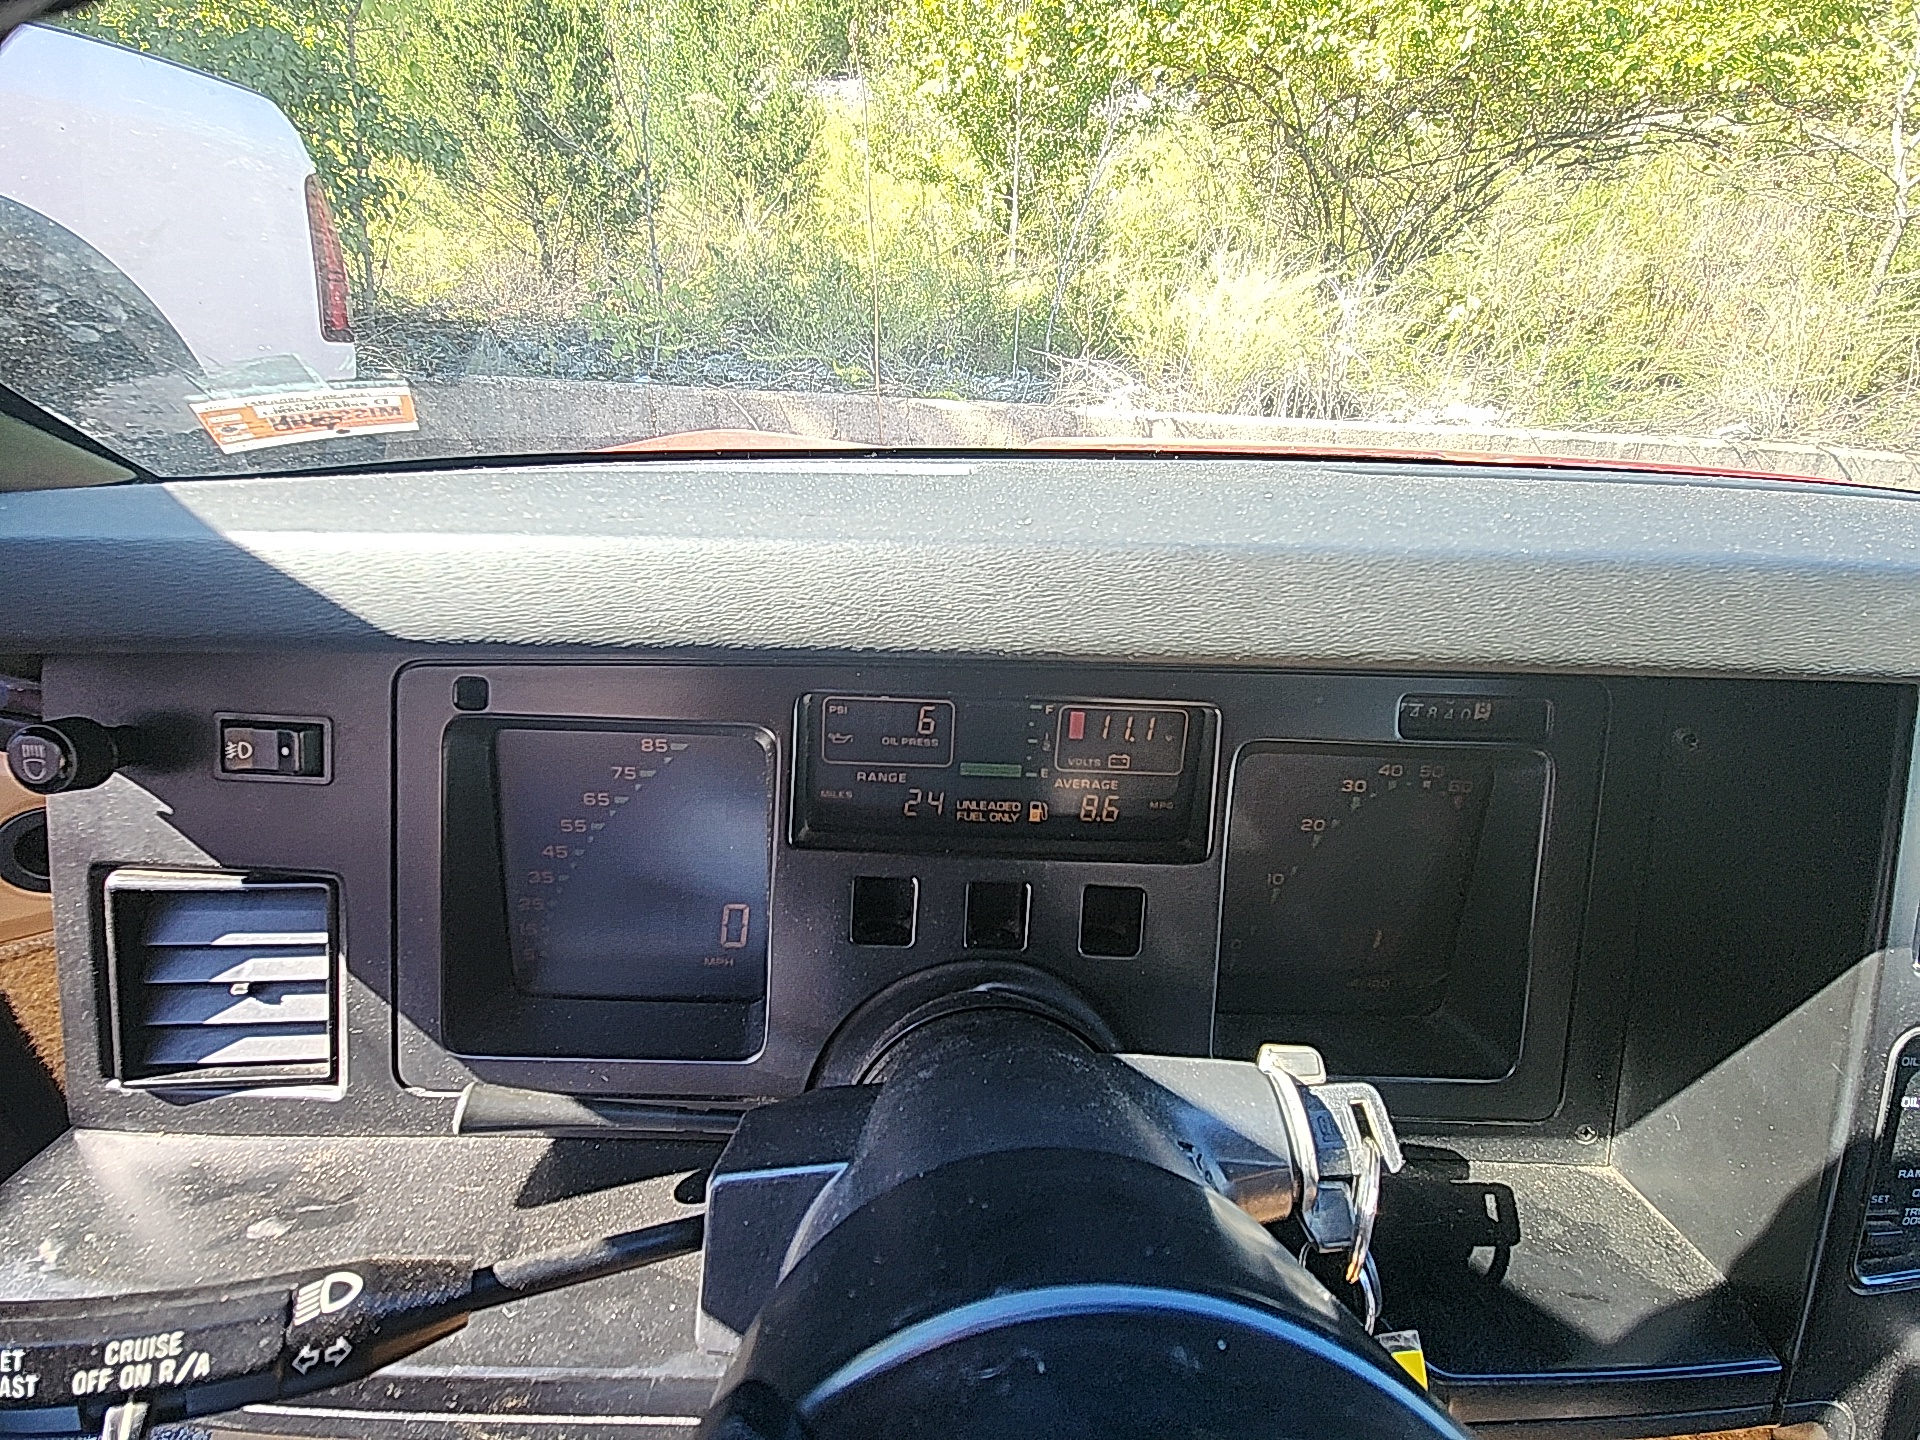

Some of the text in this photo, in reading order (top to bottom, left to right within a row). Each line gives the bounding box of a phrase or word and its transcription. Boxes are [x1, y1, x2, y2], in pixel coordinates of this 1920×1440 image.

[828, 705, 848, 714] PSI
[1045, 704, 1054, 715] F
[917, 705, 936, 735] 6
[641, 738, 668, 752] 85
[881, 736, 939, 747] OIL PRESS
[1067, 757, 1101, 767] VOLTS
[611, 766, 637, 780] 75
[856, 771, 907, 783] RANGE
[1040, 768, 1049, 779] E
[1377, 764, 1403, 777] 40
[1054, 778, 1119, 790] AVERAGE
[1341, 779, 1367, 793] 30
[583, 792, 610, 806] 65
[903, 788, 945, 816] 24
[956, 800, 1022, 811] UNLEADED
[956, 811, 1021, 823] FUEL ONLY
[560, 819, 587, 833] 55
[1300, 818, 1326, 832] 20
[542, 845, 568, 858] 45
[528, 871, 554, 884] 35
[1266, 873, 1285, 885] 10
[720, 903, 750, 949] 0
[704, 957, 734, 967] MPH
[1901, 1056, 1920, 1067] OIL
[1901, 1096, 1919, 1107] OIL
[1871, 1195, 1890, 1203] SET
[104, 1330, 185, 1366] CRUISE
[0, 1349, 26, 1372] ET
[72, 1350, 210, 1395] OFF ON R/A
[0, 1373, 40, 1398] AST
